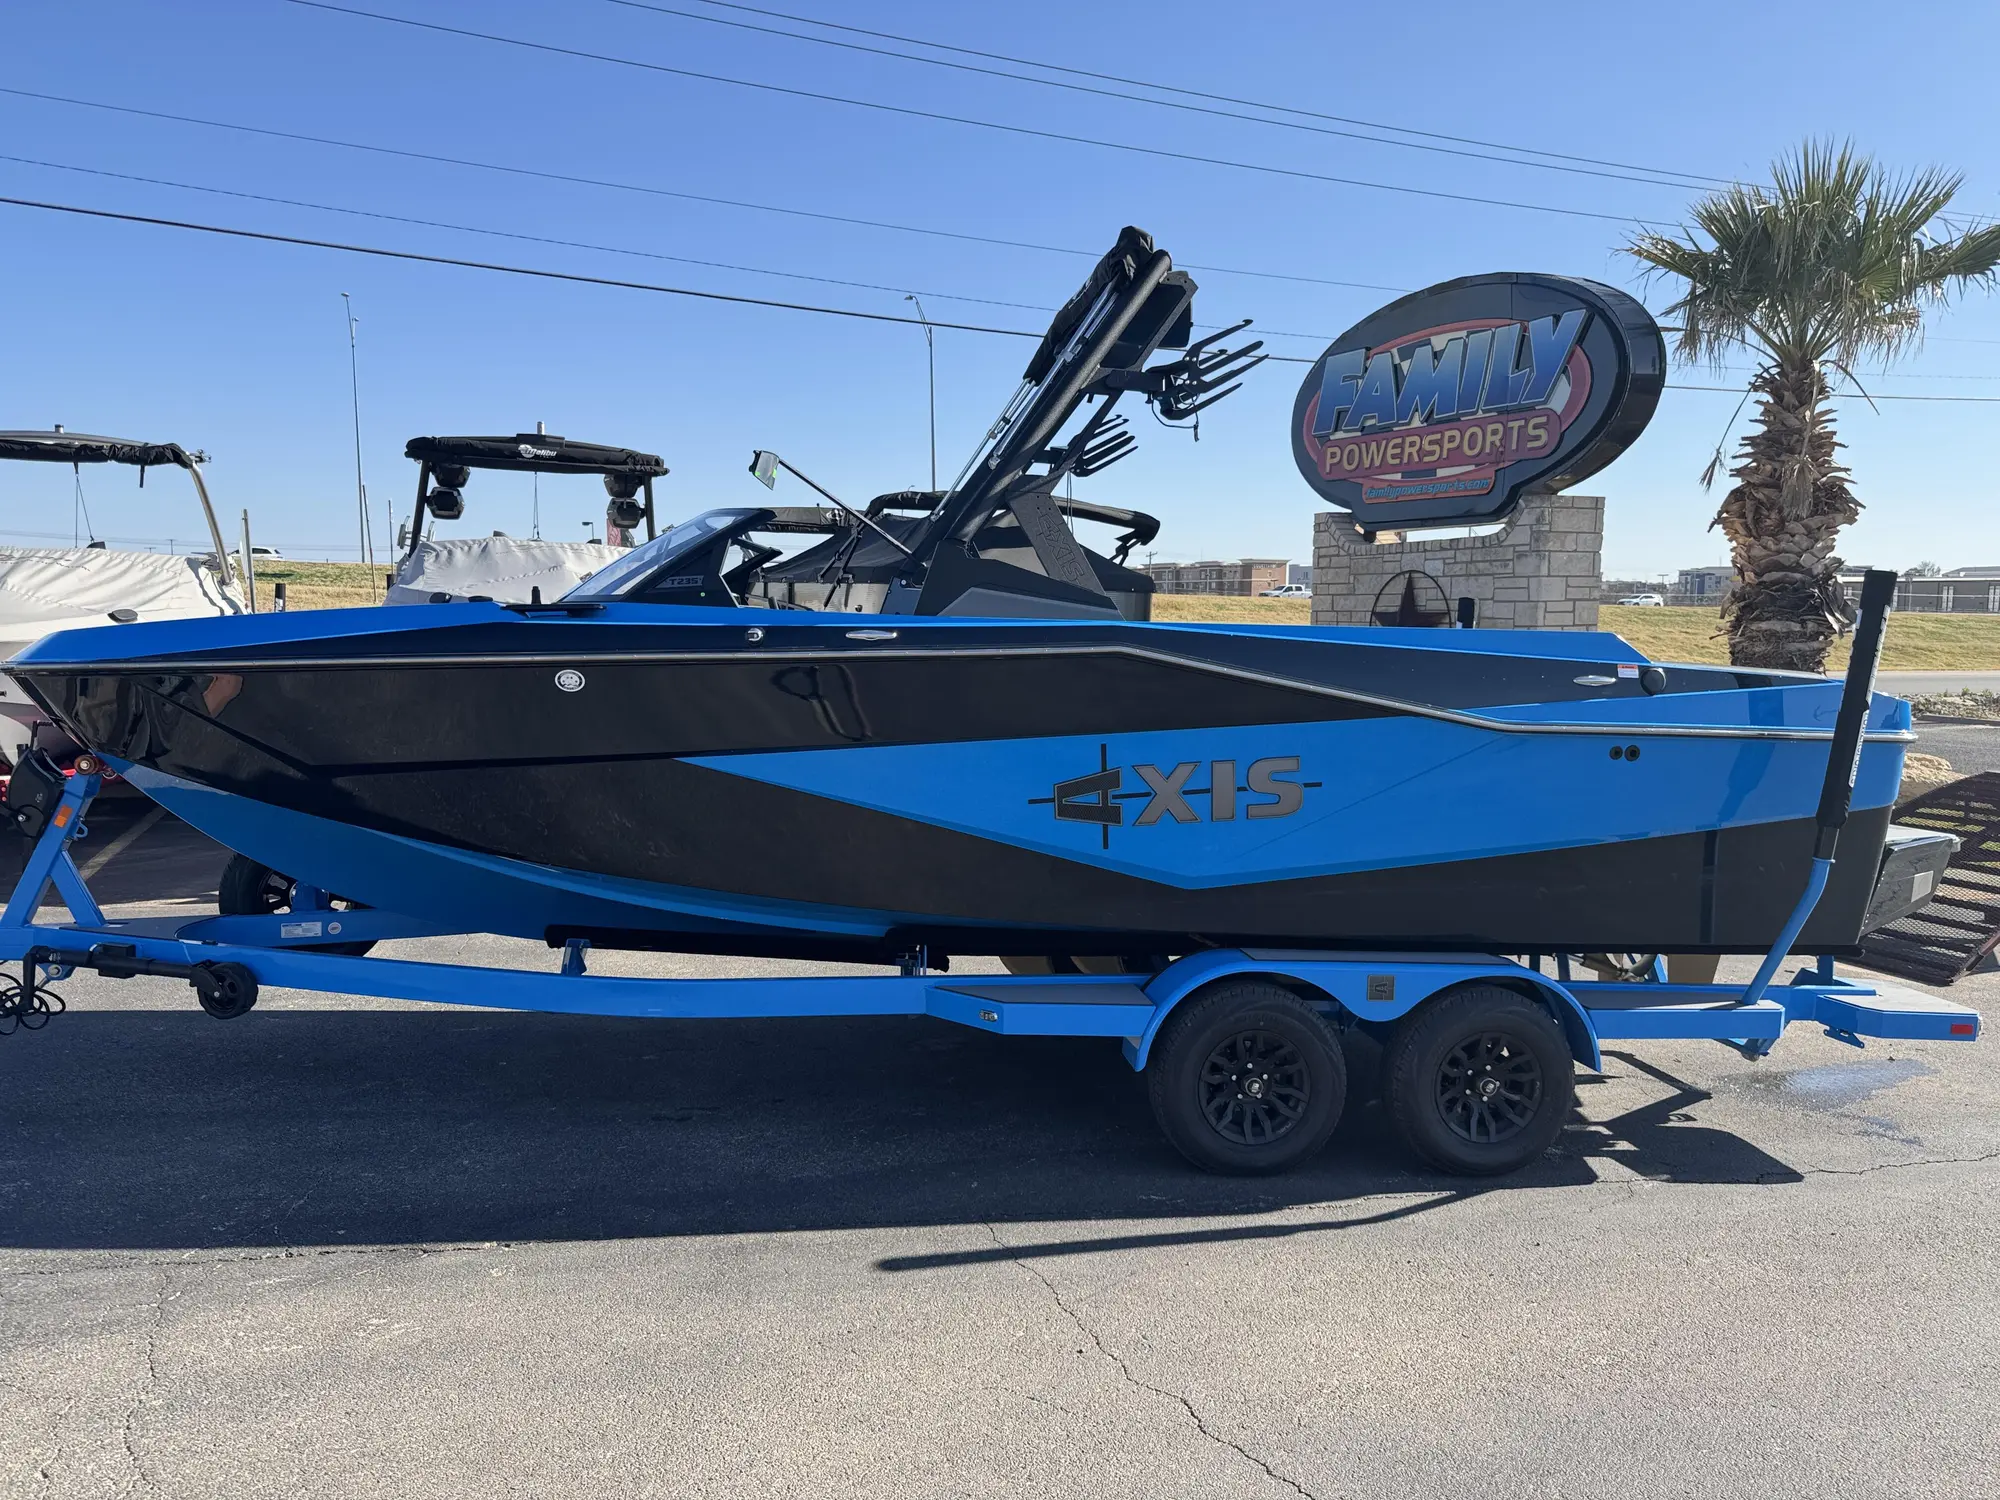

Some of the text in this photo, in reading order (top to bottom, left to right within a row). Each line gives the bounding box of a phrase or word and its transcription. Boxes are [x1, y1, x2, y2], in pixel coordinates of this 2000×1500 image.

[1312, 309, 1588, 436] FAMILY
[1324, 415, 1550, 474] POWERSPORTS
[1367, 479, 1489, 498] familypowersports.com
[669, 577, 699, 586] T235
[1053, 755, 1304, 826] AXIS
